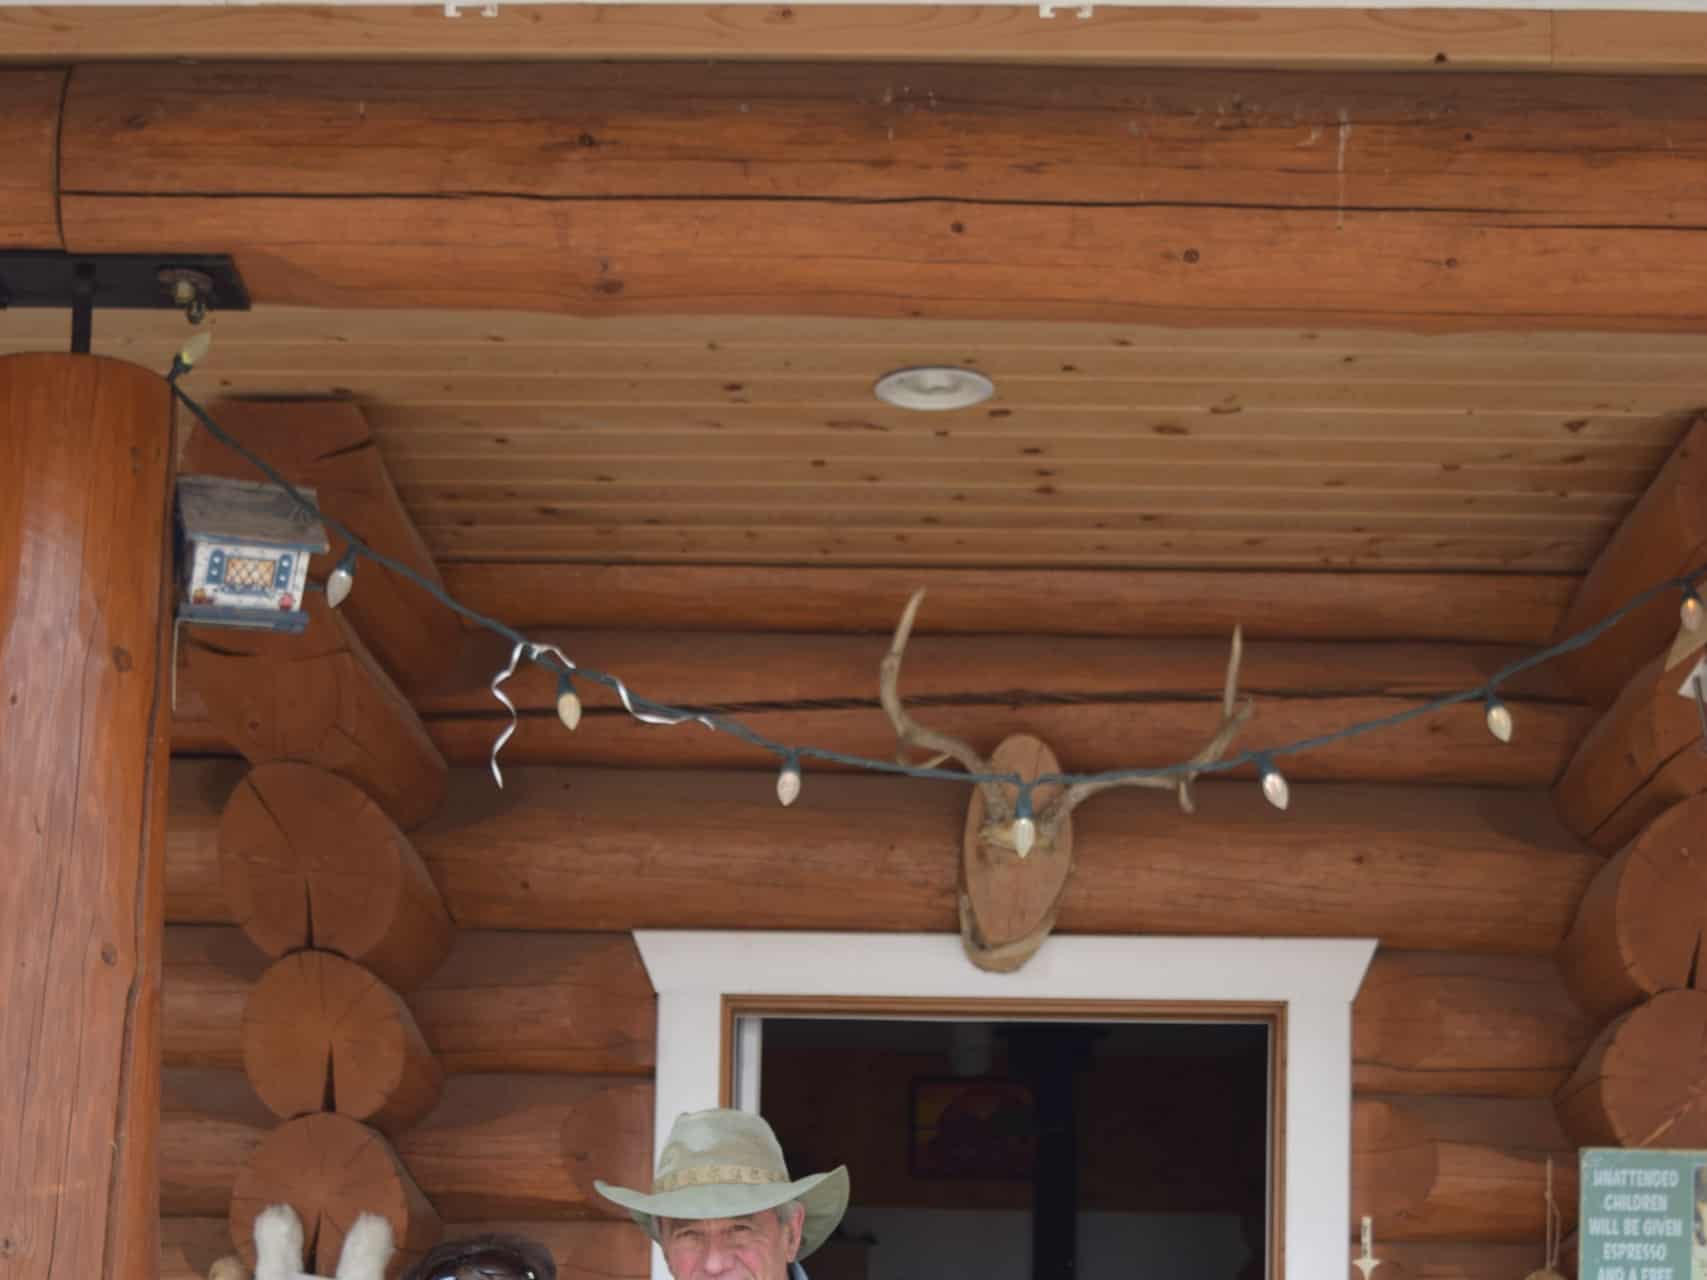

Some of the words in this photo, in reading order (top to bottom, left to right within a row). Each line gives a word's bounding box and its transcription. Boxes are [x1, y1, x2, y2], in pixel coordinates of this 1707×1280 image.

[1593, 1168, 1679, 1187] UNATTENDED
[1604, 1194, 1668, 1211] CHILDREN
[1588, 1218, 1619, 1235] WILL
[1624, 1218, 1640, 1235] BE
[1643, 1219, 1682, 1236] GIVEN
[1603, 1243, 1666, 1261] ESPRESSO
